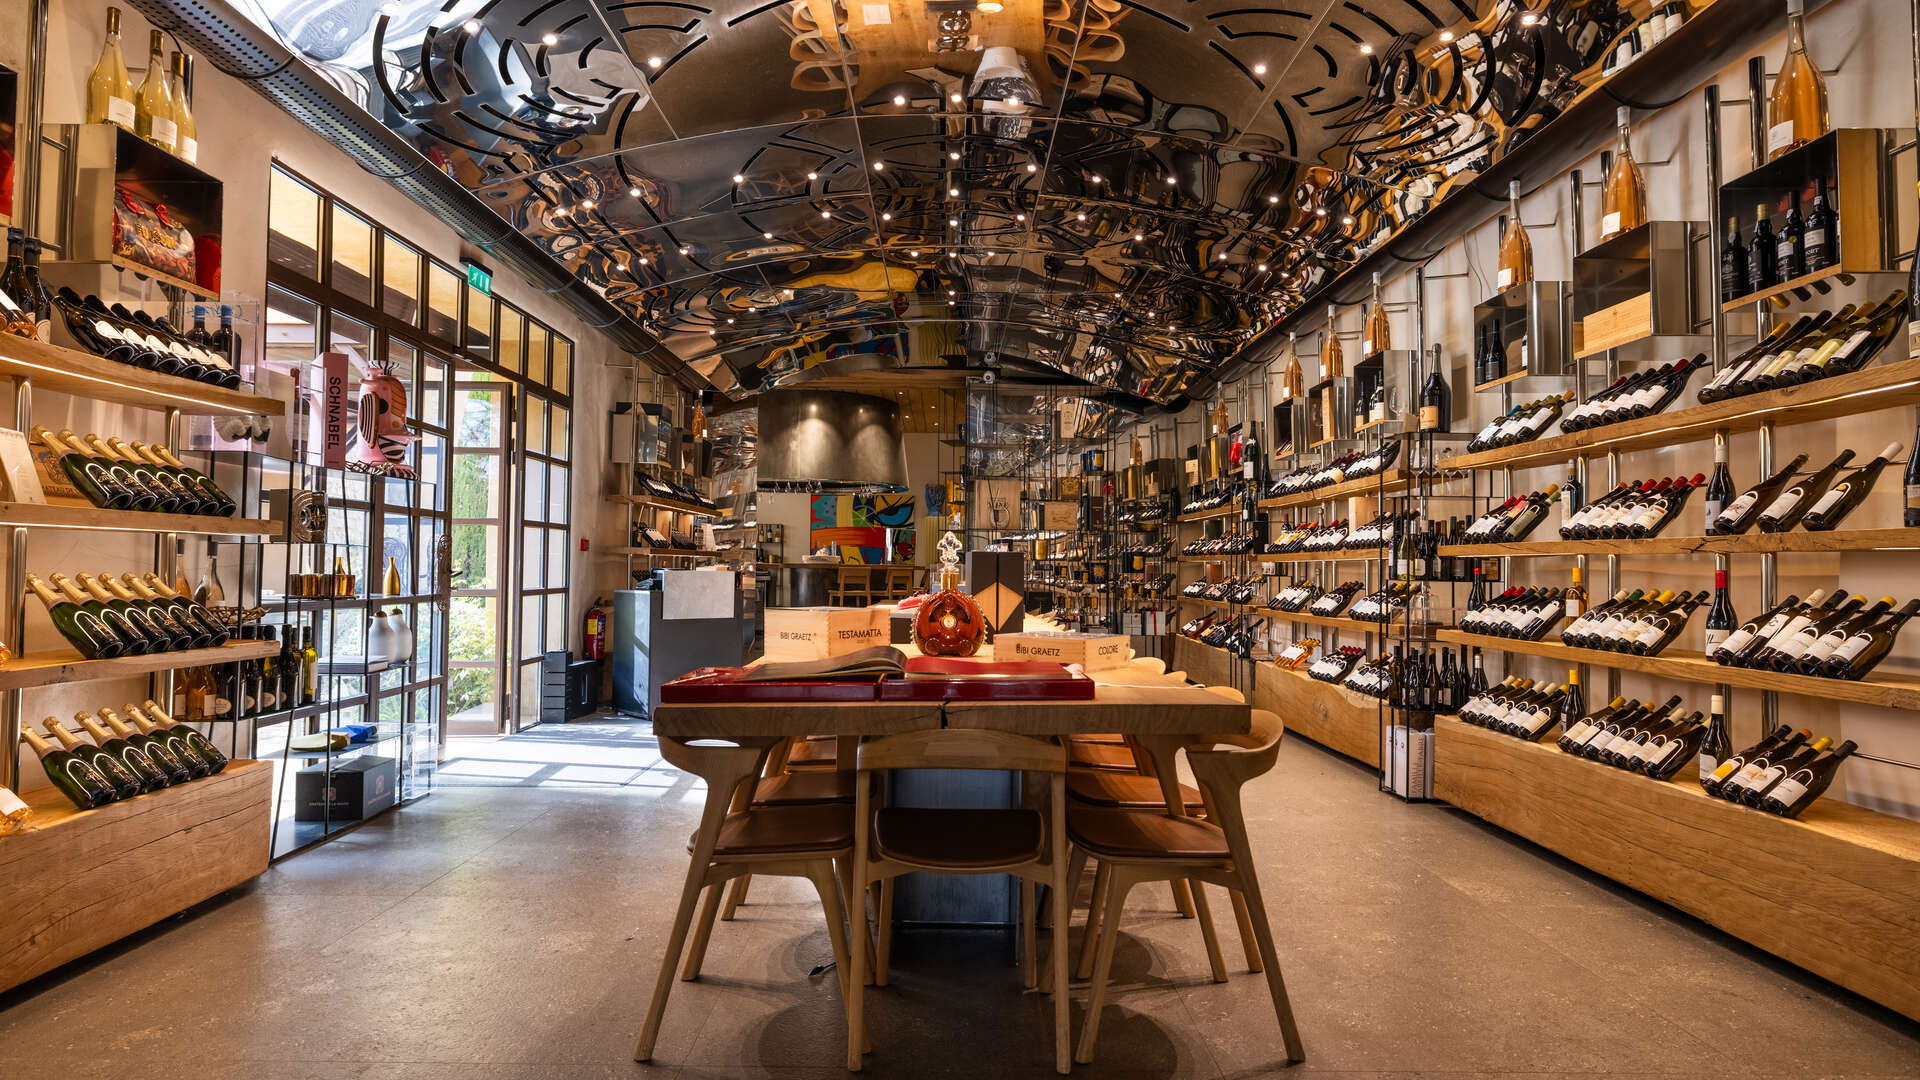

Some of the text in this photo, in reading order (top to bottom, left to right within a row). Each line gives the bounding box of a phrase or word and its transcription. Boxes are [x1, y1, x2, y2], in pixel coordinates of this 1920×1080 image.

[328, 376, 341, 450] SCHNABEL
[780, 631, 812, 641] BIBI GRAETZ
[838, 628, 882, 640] TESTAMATTA
[1016, 643, 1060, 657] BIBI GRAETZ
[1098, 644, 1118, 656] COLORE
